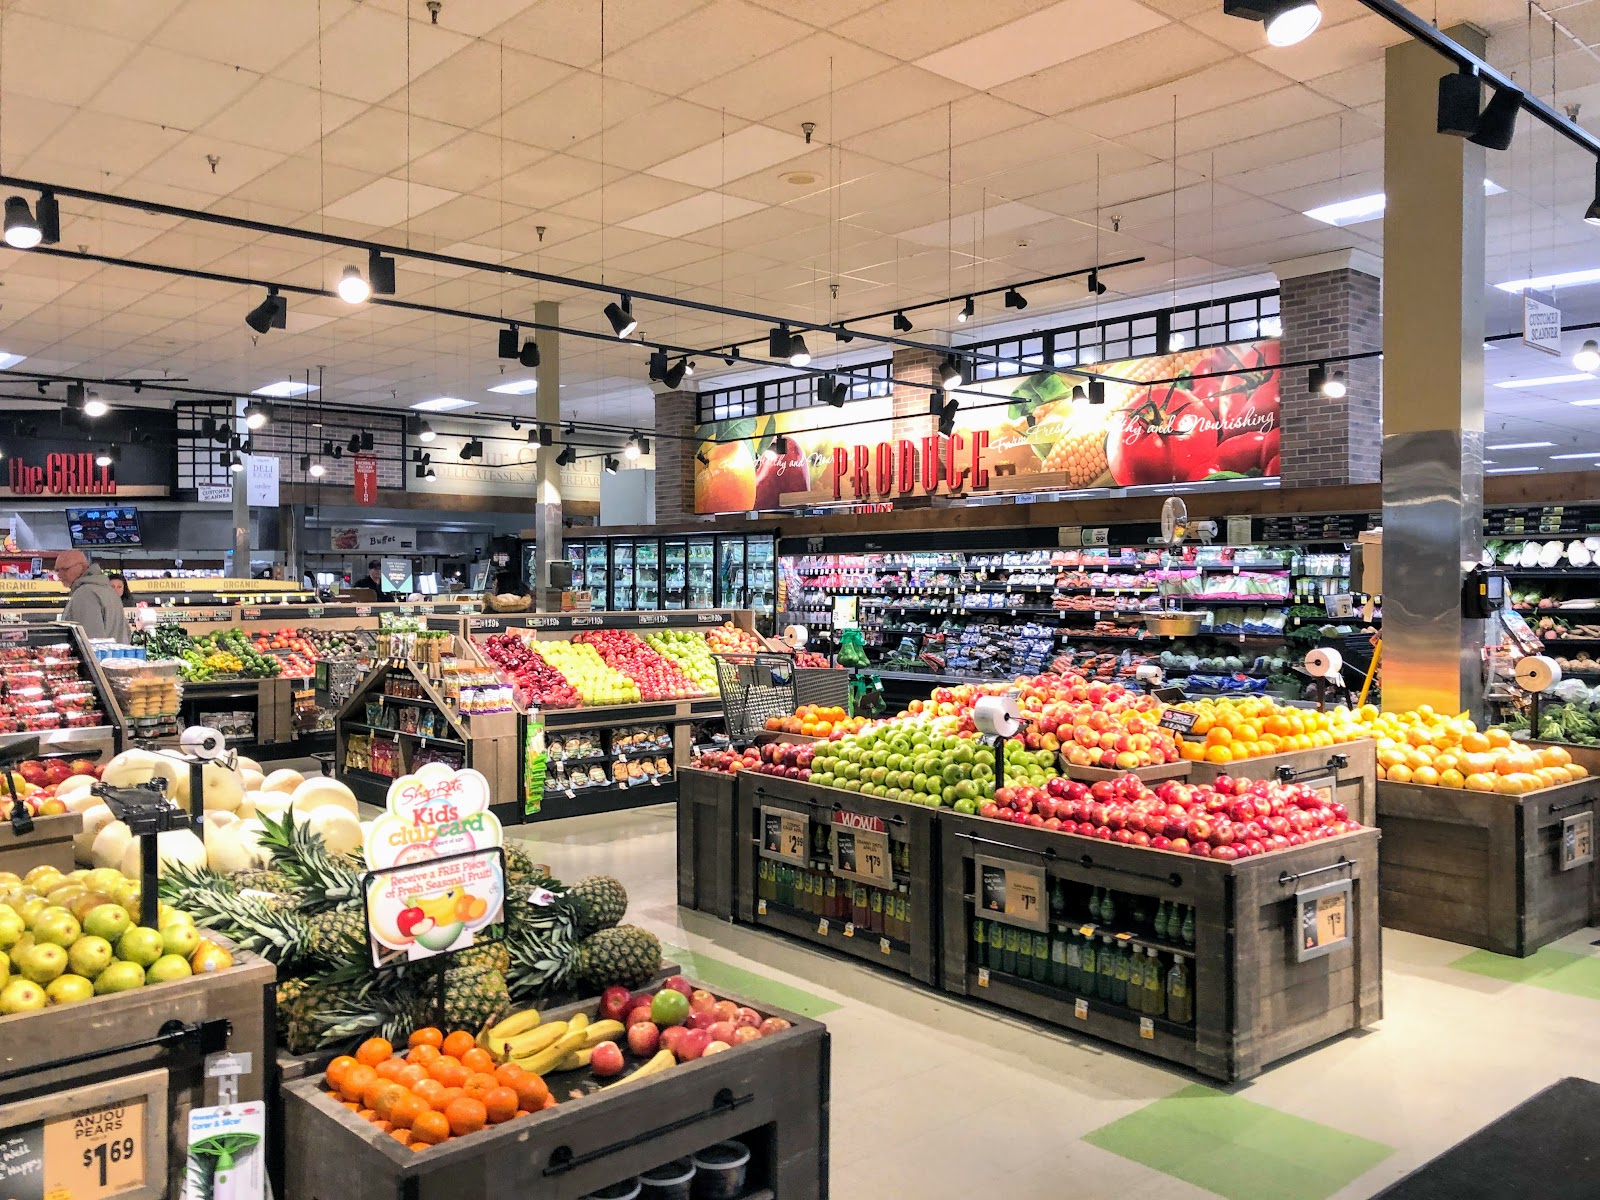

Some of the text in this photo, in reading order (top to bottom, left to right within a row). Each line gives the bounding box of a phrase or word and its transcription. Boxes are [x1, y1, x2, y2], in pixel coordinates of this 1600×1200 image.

[1529, 312, 1559, 326] CUSTOMER
[1531, 327, 1559, 341] SCANNER
[1147, 415, 1175, 435] and
[1179, 406, 1276, 435] Nourishing
[46, 452, 117, 495] GRILL
[253, 464, 273, 473] DELI
[832, 429, 990, 499] PRODUCE
[8, 457, 44, 495] the
[369, 535, 396, 546] Buffet
[0, 581, 37, 591] RGANIC
[147, 581, 186, 589] ORGANIC
[412, 804, 459, 828] Kids
[841, 812, 877, 831] WOW!
[390, 873, 427, 887] Receive
[437, 863, 461, 877] FREE
[463, 860, 487, 872] Piece
[385, 887, 396, 899] of
[398, 884, 424, 897] Fresh
[426, 873, 466, 890] Seasonal
[73, 1108, 125, 1130] ANJOU
[75, 1120, 123, 1140] PEARS
